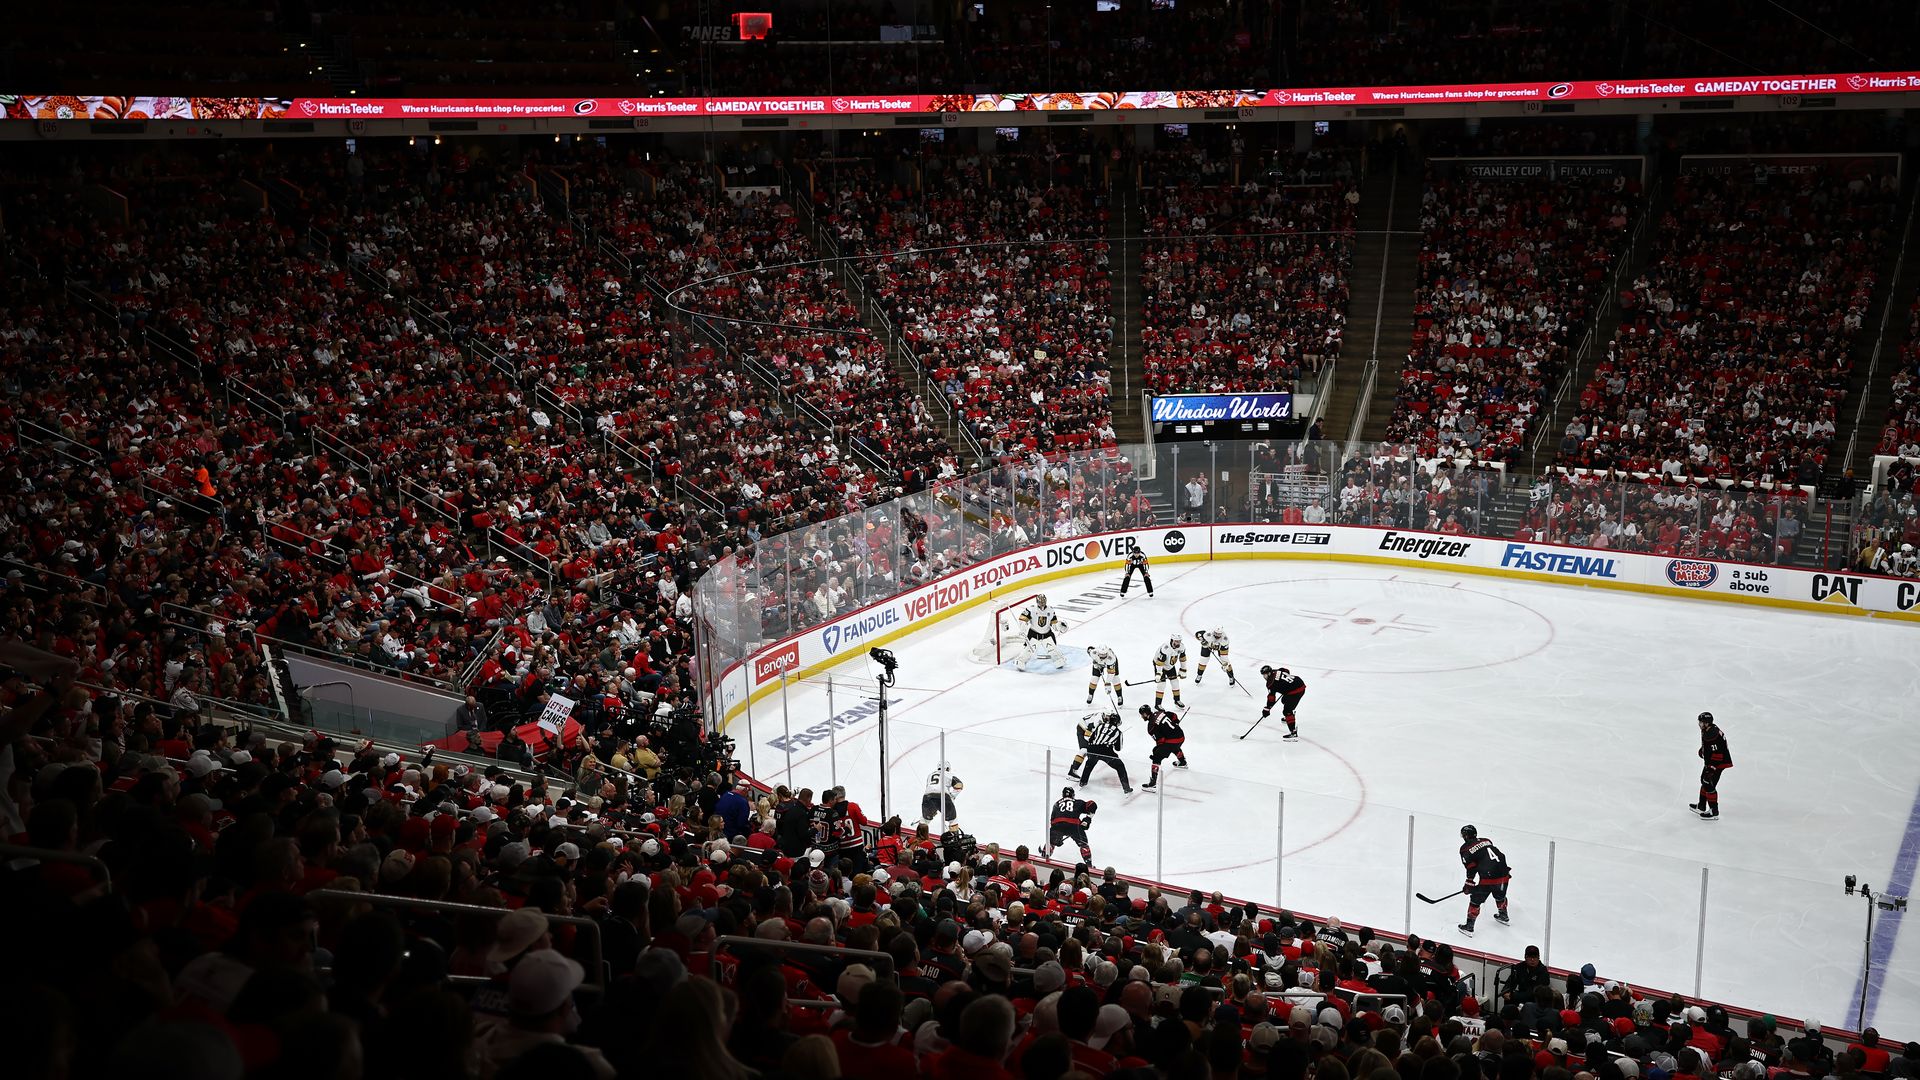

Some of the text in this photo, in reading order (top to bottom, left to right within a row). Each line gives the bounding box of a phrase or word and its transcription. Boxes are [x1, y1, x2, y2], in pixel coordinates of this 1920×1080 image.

[1694, 79, 1837, 93] GAMEDAY TOGETHER
[1372, 87, 1538, 100] Where Hurricanes fans shop for groceries!
[401, 104, 566, 115] Where Hurricanes fans shop for groceries!
[705, 101, 825, 112] GAMEDAY TOGETHER
[1521, 166, 1542, 176] CUP
[1153, 397, 1290, 420] Window World
[1164, 536, 1185, 551] abc
[1293, 532, 1330, 546] BET
[1378, 531, 1471, 559] Energizer
[1500, 543, 1618, 578] FASTENAL
[1673, 561, 1711, 573] Jersey
[972, 554, 1041, 590] HONDA
[1732, 570, 1768, 581] a sub
[1729, 581, 1770, 594] above
[1811, 573, 1863, 606] CAT
[903, 578, 970, 622] verizon
[843, 607, 901, 643] FANDUEL
[757, 650, 797, 677] Lenovo
[1059, 800, 1074, 813] 28
[1486, 846, 1501, 863] 4
